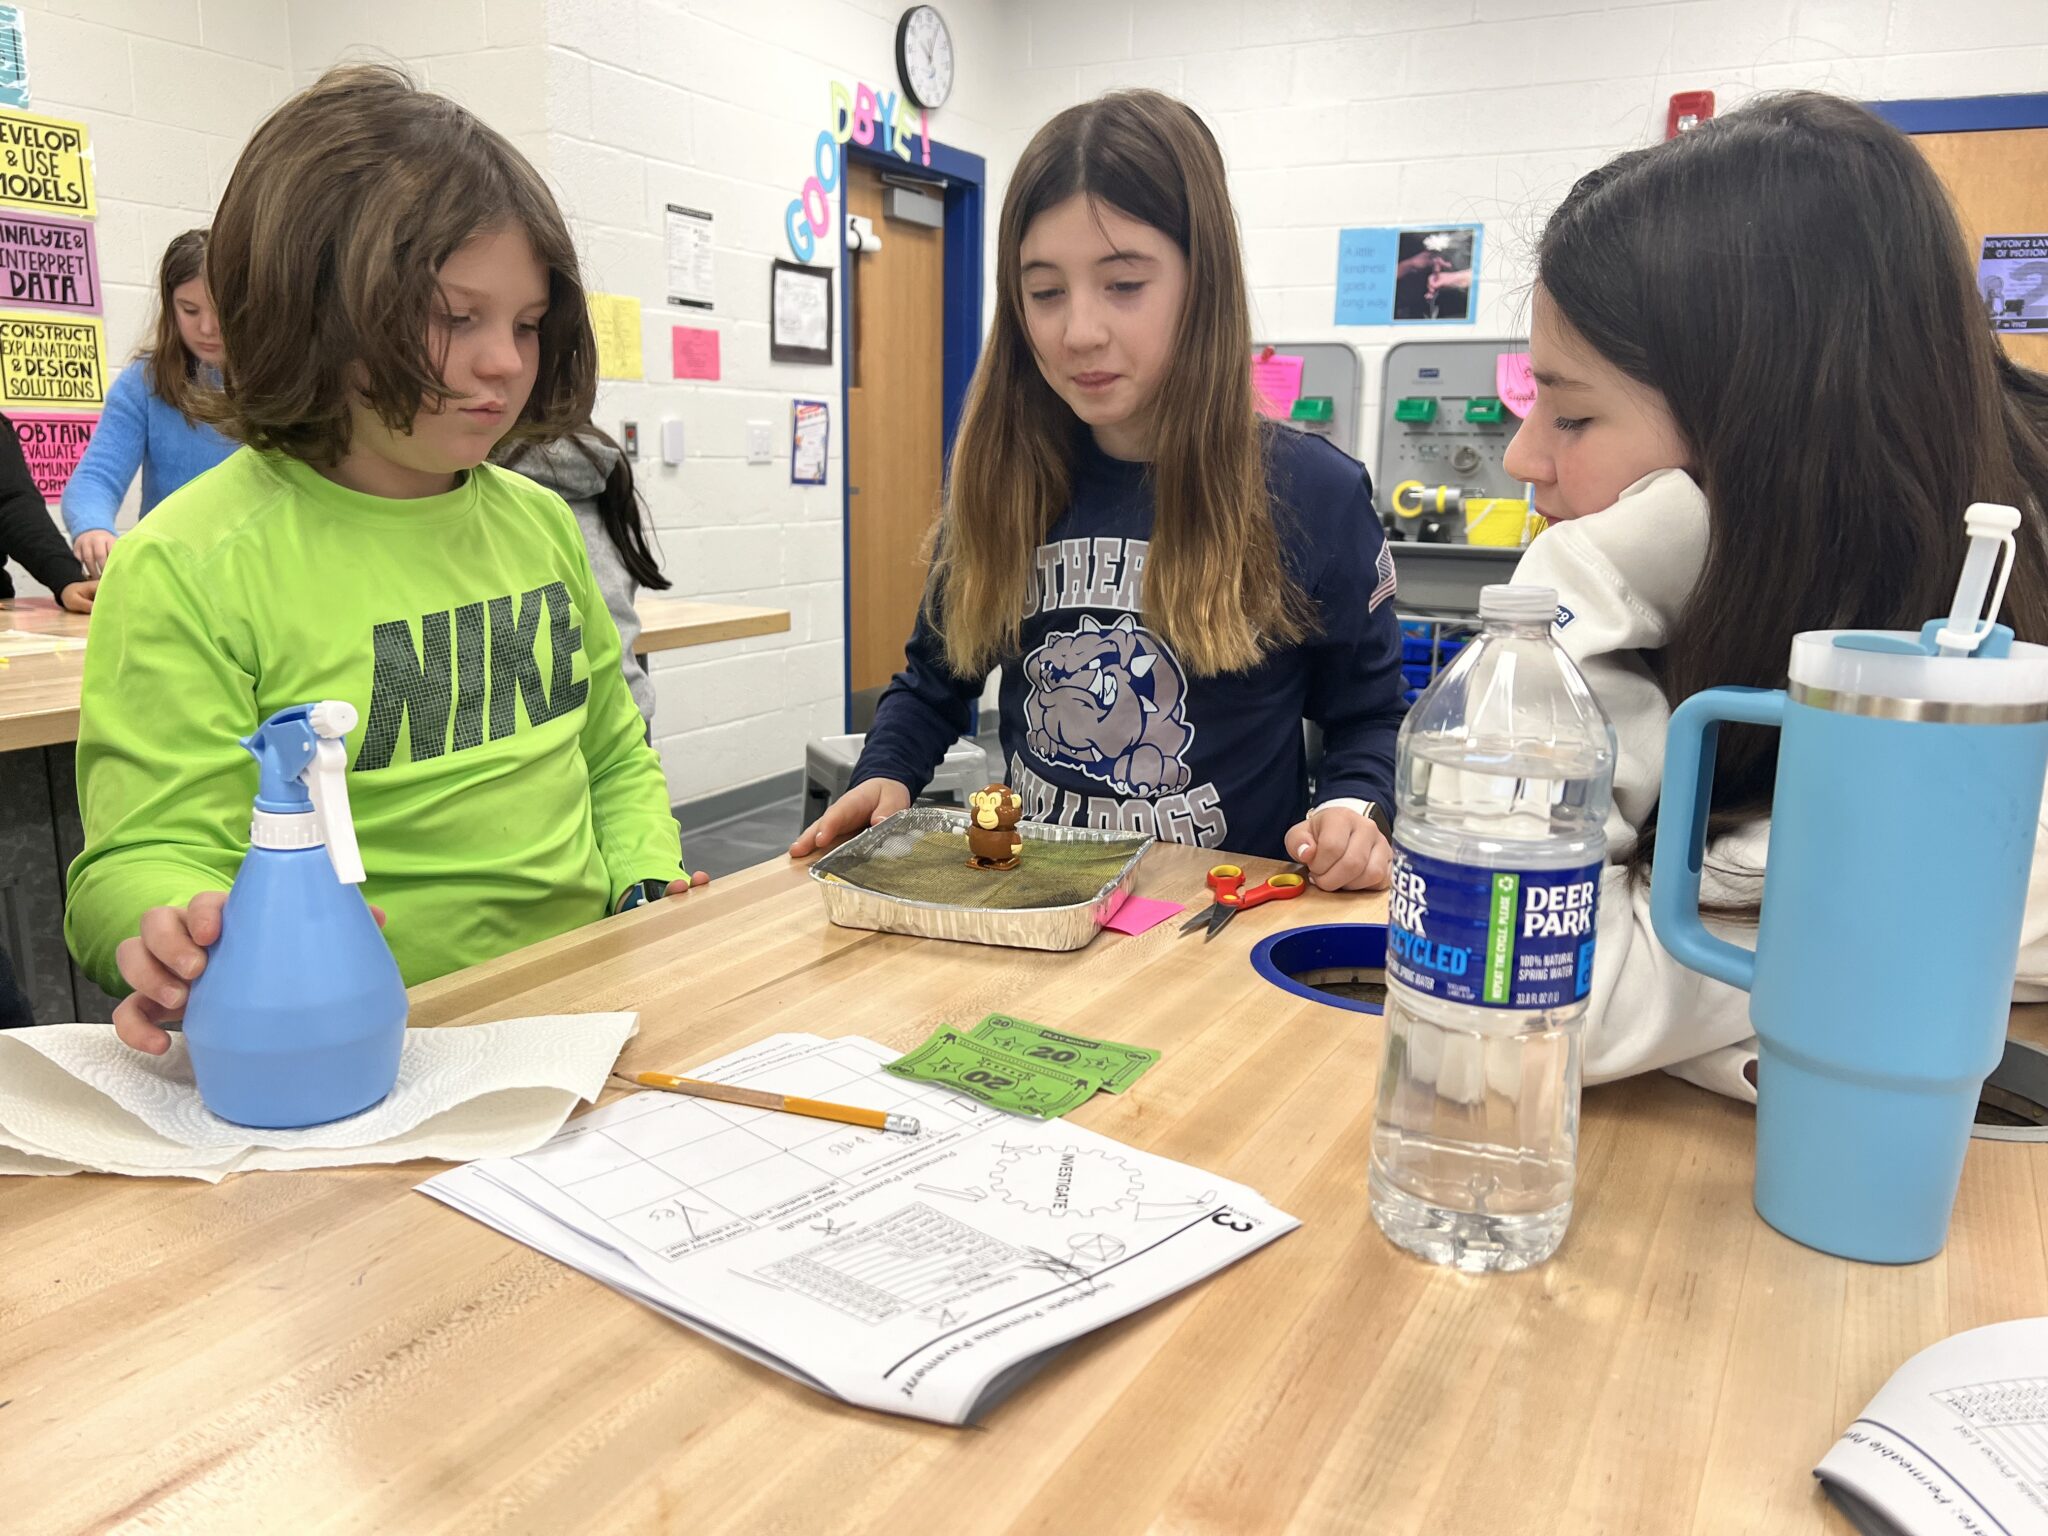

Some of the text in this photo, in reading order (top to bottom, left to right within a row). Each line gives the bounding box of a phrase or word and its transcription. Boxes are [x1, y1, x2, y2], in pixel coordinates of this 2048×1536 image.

[0, 122, 76, 153] EVELOP
[6, 148, 60, 178] & USE
[10, 271, 78, 303] DATA
[0, 324, 92, 342] CONSTRUCT
[2, 340, 96, 360] EXPLANATIONS
[11, 378, 94, 398] SOLUTIONS
[352, 581, 589, 772] NIKE
[1391, 867, 1427, 905] EER
[1526, 881, 1594, 912] DEER
[1390, 889, 1427, 938] ARK
[1523, 906, 1592, 937] PARK
[1519, 968, 1548, 981] SPRING
[1027, 1046, 1077, 1062] 20
[964, 1071, 1013, 1090] 20
[1053, 1153, 1075, 1209] INVESTIGATE
[1212, 1213, 1253, 1232] 3
[1870, 1440, 1952, 1504] Permeable
